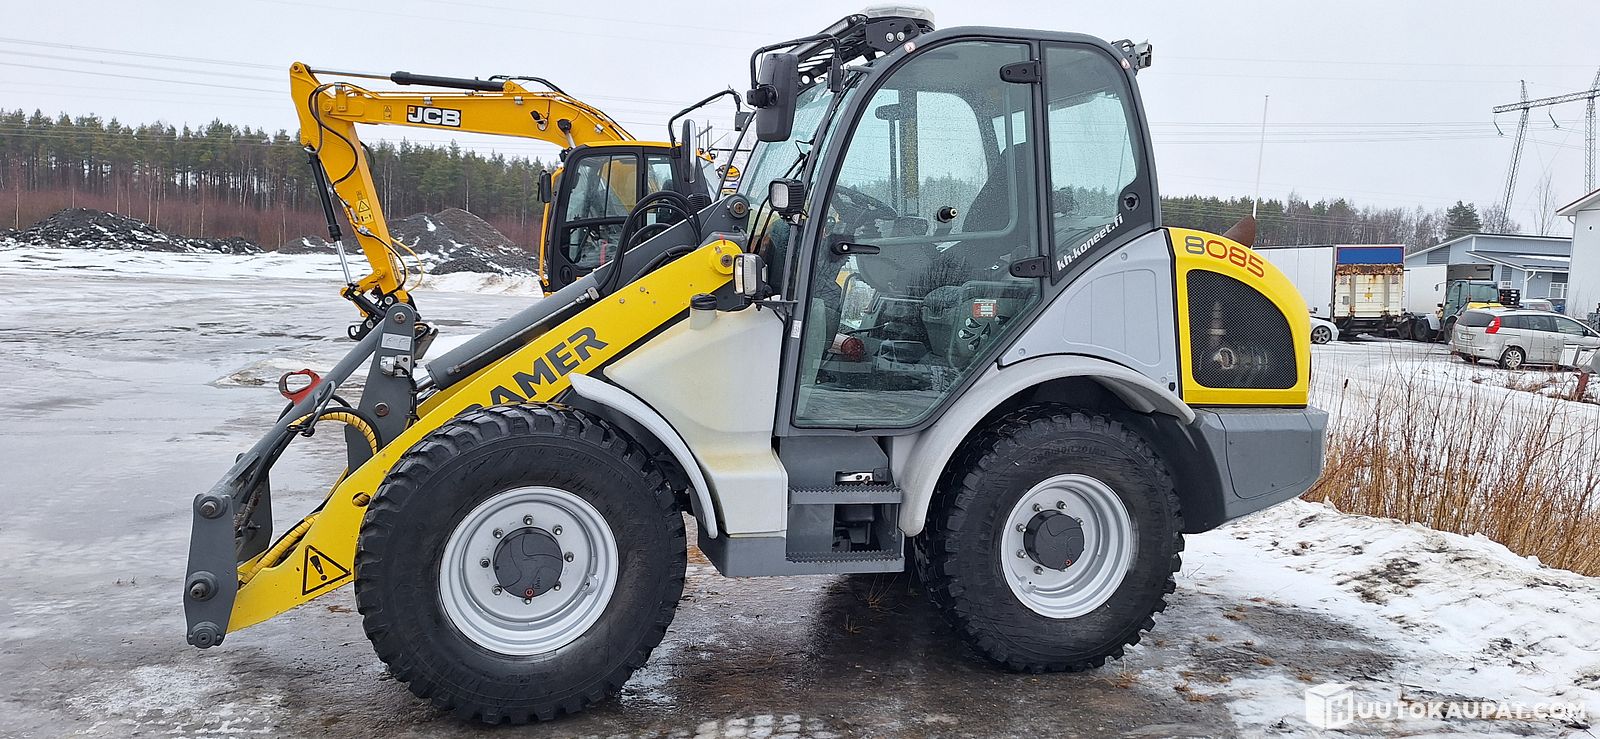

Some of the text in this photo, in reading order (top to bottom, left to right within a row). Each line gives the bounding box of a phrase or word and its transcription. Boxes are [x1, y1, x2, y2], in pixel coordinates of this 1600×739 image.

[408, 107, 460, 126] JCB
[1057, 213, 1123, 271] kh-koneet.fi
[1185, 236, 1264, 278] 8085
